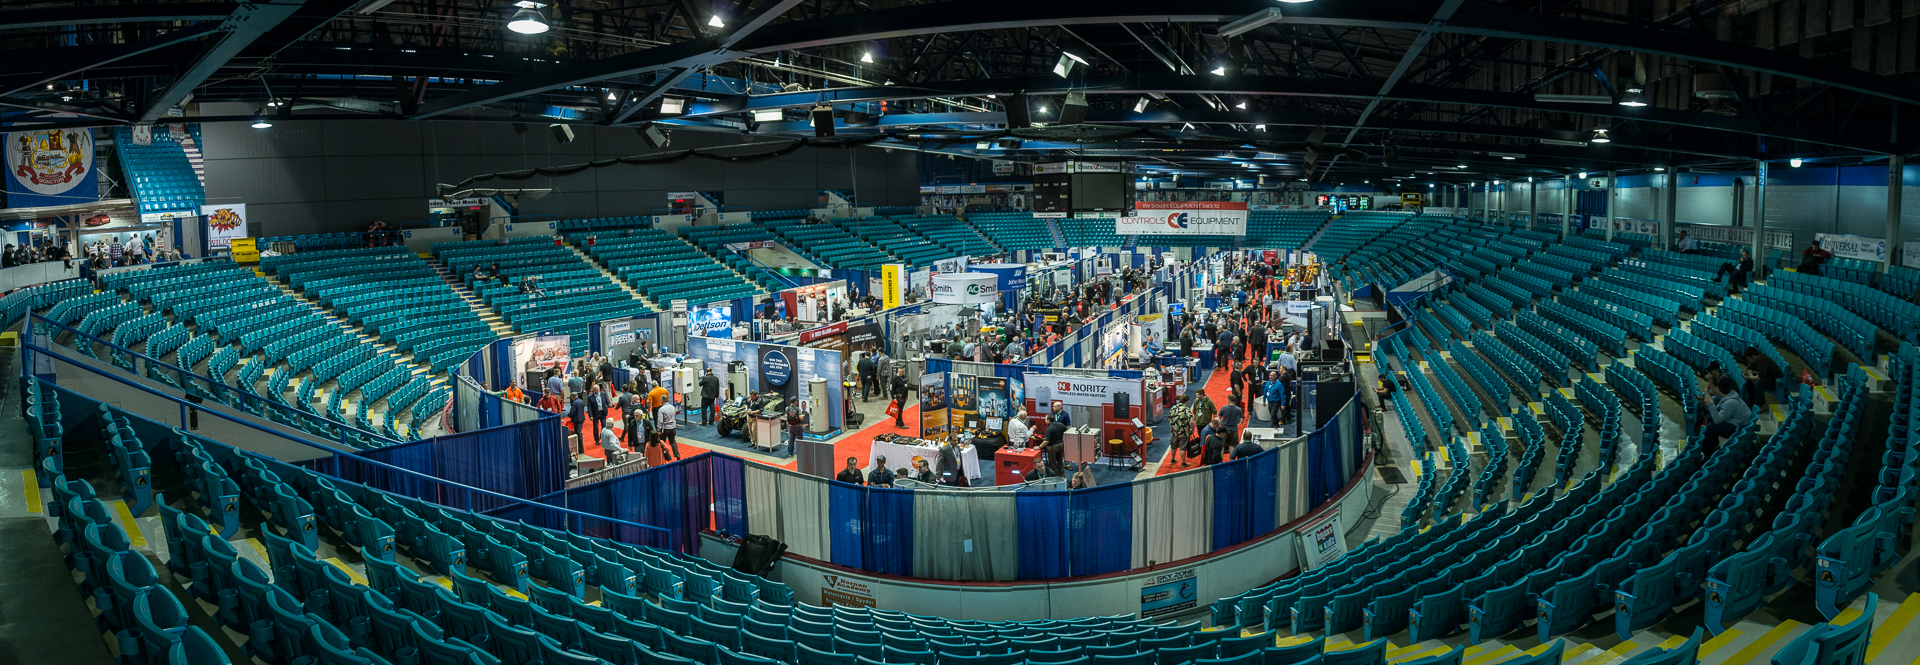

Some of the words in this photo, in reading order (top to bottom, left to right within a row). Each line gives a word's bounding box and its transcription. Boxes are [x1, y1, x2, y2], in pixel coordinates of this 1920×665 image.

[1121, 217, 1166, 225] CONTROLS
[1190, 217, 1241, 225] EQUIPMENT
[402, 230, 412, 238] 15
[1690, 225, 1726, 240] DELIVERING
[1728, 229, 1754, 242] QUALIT
[1763, 231, 1793, 248] SERVICE
[209, 238, 231, 246] WILDC
[1824, 240, 1859, 253] UNIVERSAL
[980, 285, 997, 293] Smit
[695, 321, 728, 331] Dettson
[1073, 384, 1107, 393] NORITZ
[836, 581, 872, 594] Academy
[840, 578, 868, 589] Dornan
[823, 589, 851, 601] Motorcycle
